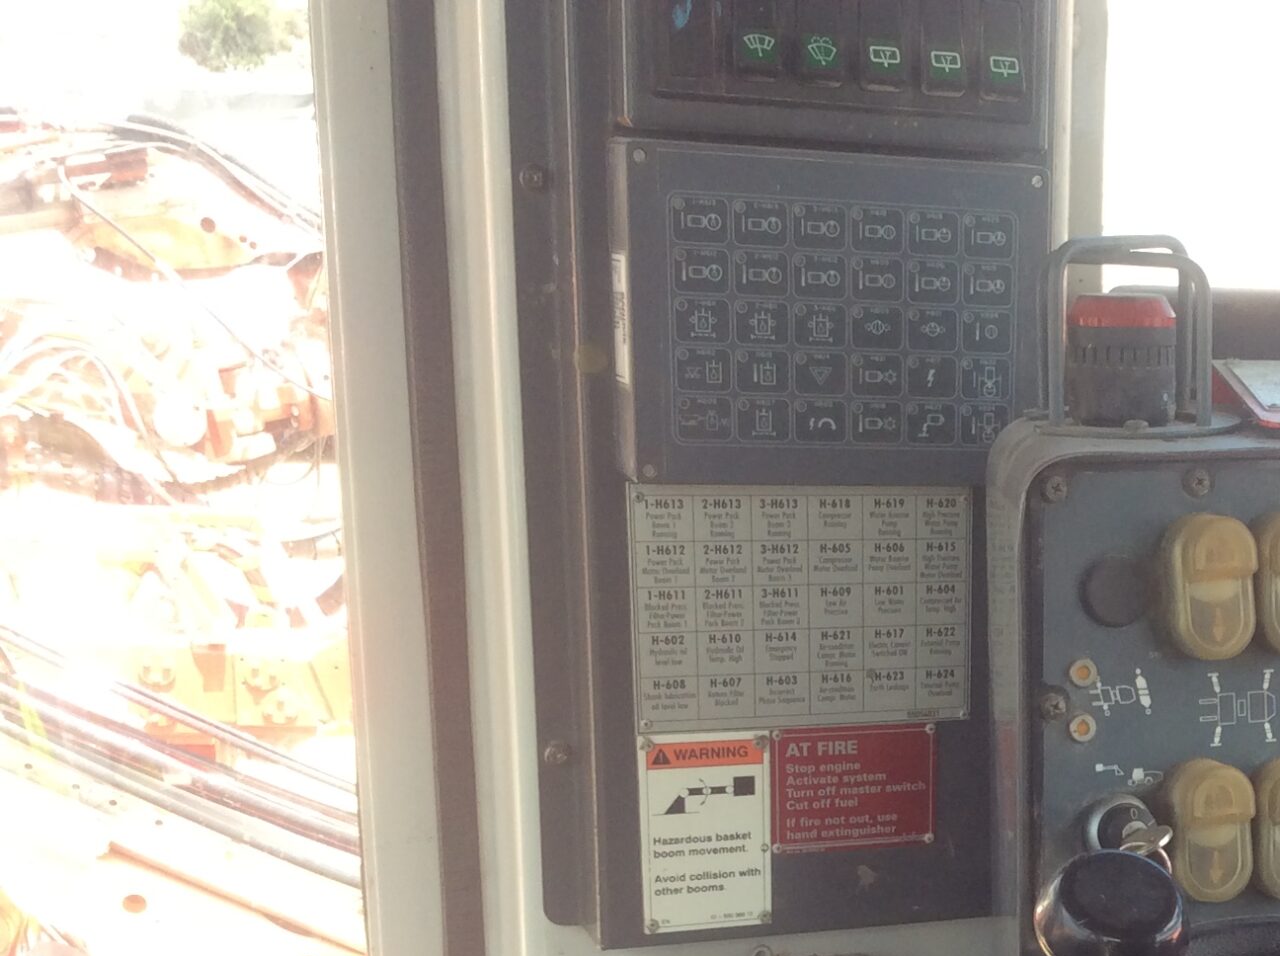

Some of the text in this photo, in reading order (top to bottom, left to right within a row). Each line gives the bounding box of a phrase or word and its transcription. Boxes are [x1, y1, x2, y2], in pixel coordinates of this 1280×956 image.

[645, 499, 684, 509] 1-H613
[702, 499, 741, 509] 2-H613
[760, 499, 798, 509] 3-H613
[820, 499, 850, 508] H-618
[874, 499, 904, 508] H-619
[927, 499, 956, 508] H-620
[646, 545, 685, 555] 1-H612
[703, 545, 742, 555] 2-H612
[761, 544, 798, 554] 3-H612
[820, 544, 850, 553] H-605
[875, 543, 904, 553] H-606
[927, 542, 956, 551] H-615
[705, 590, 742, 599] 2-H611
[761, 588, 798, 598] 3-H611
[821, 587, 851, 597] H-609
[875, 587, 903, 595] H-601
[927, 585, 955, 594] H-604
[648, 590, 685, 600] 1-H611
[765, 632, 797, 642] H-614
[821, 631, 850, 640] H-621
[875, 629, 904, 638] H-617
[927, 628, 955, 637] H-622
[652, 636, 685, 645] H-602
[709, 634, 741, 643] H-610
[822, 674, 852, 683] H-616
[875, 671, 904, 681] H-623
[926, 670, 954, 679] H-624
[653, 680, 686, 690] H-608
[710, 678, 741, 688] H-607
[766, 676, 797, 686] H-603
[673, 746, 748, 760] WARNING
[786, 740, 858, 757] AT FIRE
[786, 762, 861, 774] Stop engine
[786, 773, 886, 786] Activate system
[786, 781, 926, 798] Turn off master switch
[787, 797, 858, 810] Cut off fuel
[787, 818, 796, 828] If
[801, 817, 821, 827] fire
[825, 815, 846, 825] not
[877, 813, 898, 822] use
[787, 825, 896, 840] hand extinguisher
[653, 832, 752, 846] Hazardous basket
[653, 850, 685, 859] boom
[655, 868, 761, 883] Avoid collision with
[655, 886, 683, 896] other
